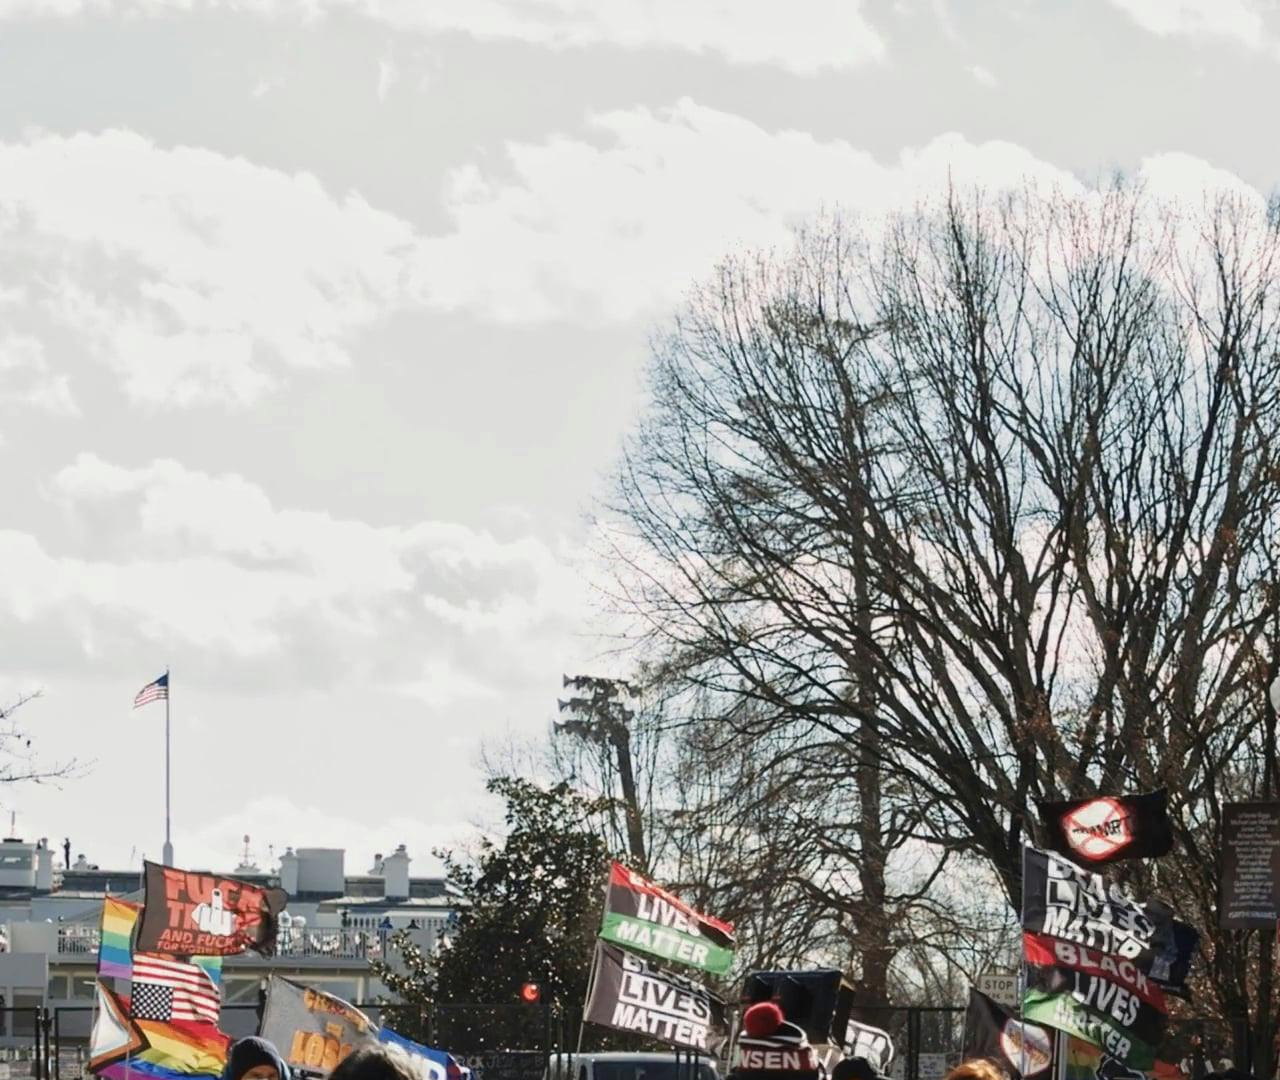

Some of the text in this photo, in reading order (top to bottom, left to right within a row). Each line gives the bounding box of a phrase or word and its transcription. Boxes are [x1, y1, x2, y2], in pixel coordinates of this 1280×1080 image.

[636, 893, 701, 937] LIVES
[160, 929, 192, 946] AND
[197, 934, 236, 949] FUCK
[616, 920, 710, 967] MATTER
[984, 980, 1013, 991] STOP
[1054, 941, 1150, 996] BLACK
[621, 971, 711, 1023] LIVES
[1071, 972, 1140, 1027] LIVES
[612, 1002, 708, 1049] MATTER
[1054, 999, 1132, 1060] MATTER
